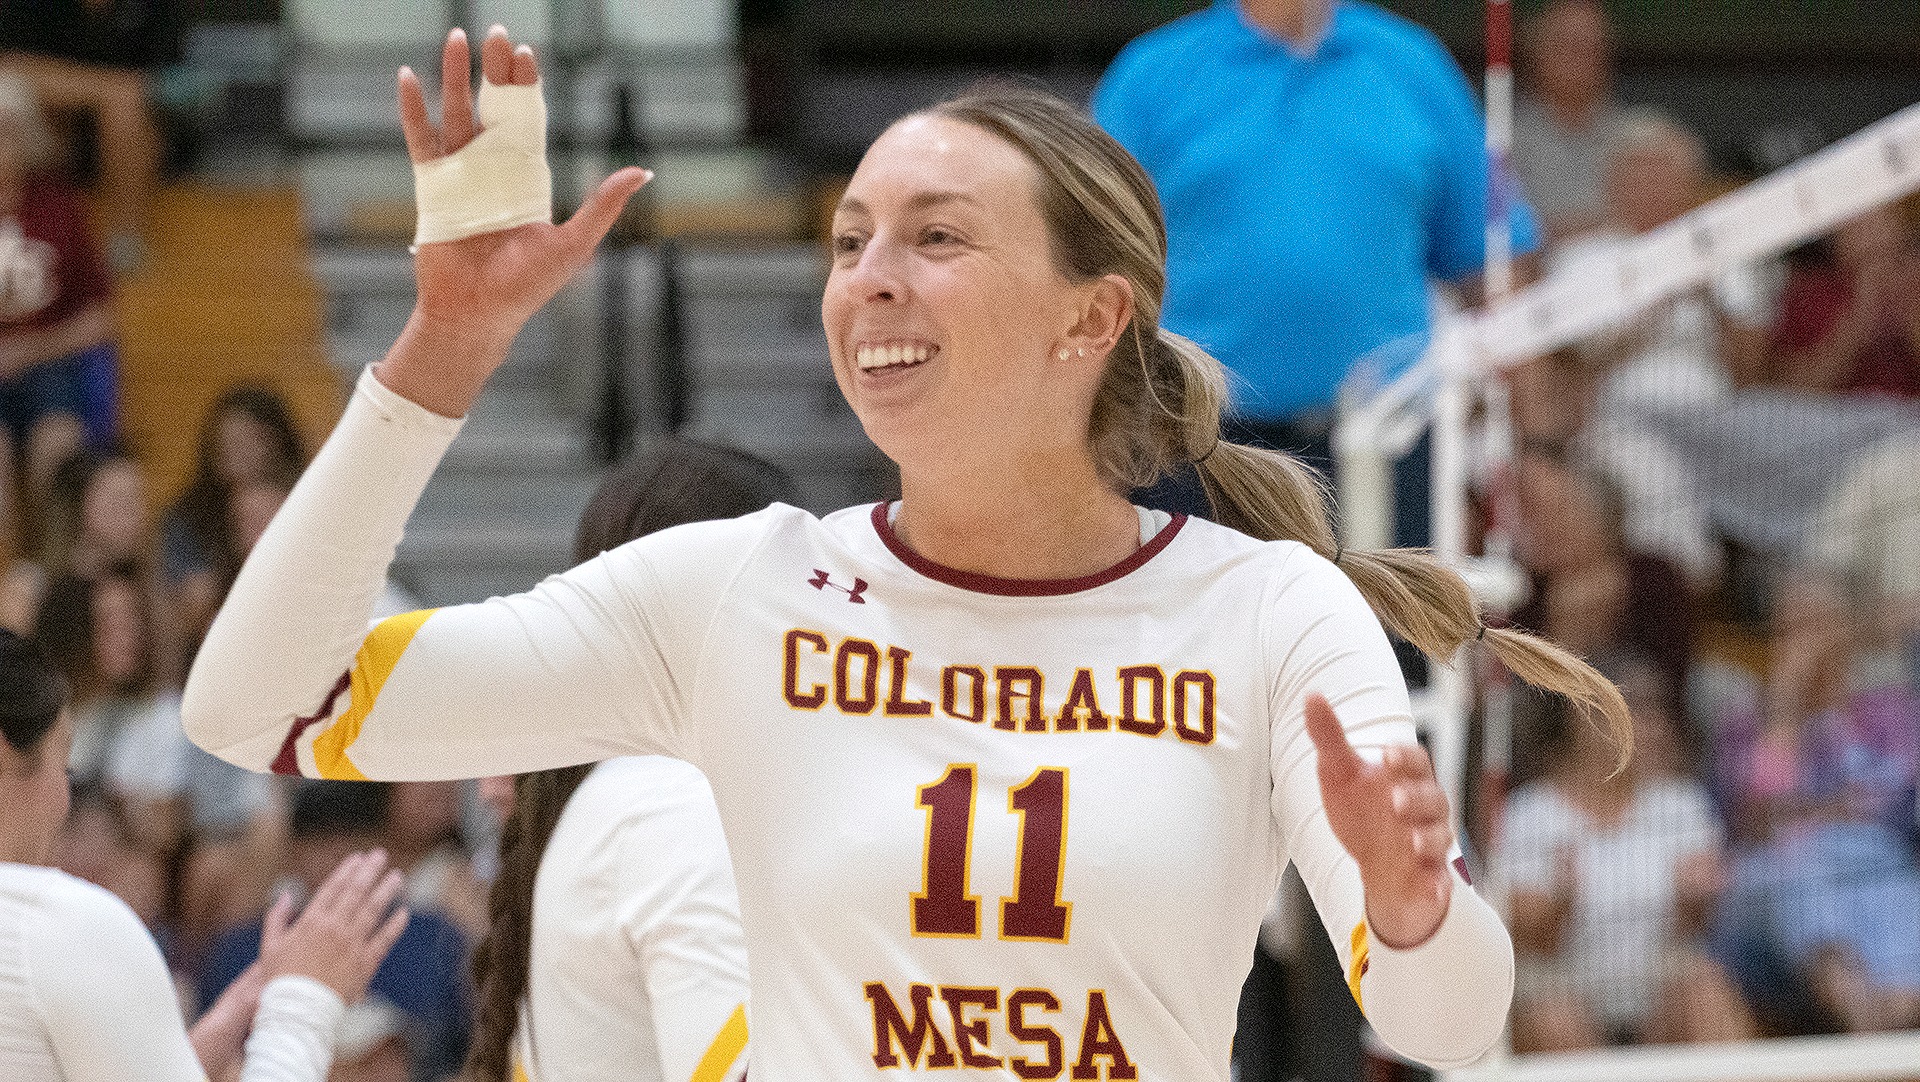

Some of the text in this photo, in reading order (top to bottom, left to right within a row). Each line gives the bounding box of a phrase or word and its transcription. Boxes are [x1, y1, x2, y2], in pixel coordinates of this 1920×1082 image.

[782, 628, 1217, 745] COLORADO
[909, 763, 1073, 944] 11
[863, 981, 1139, 1082] MESA
